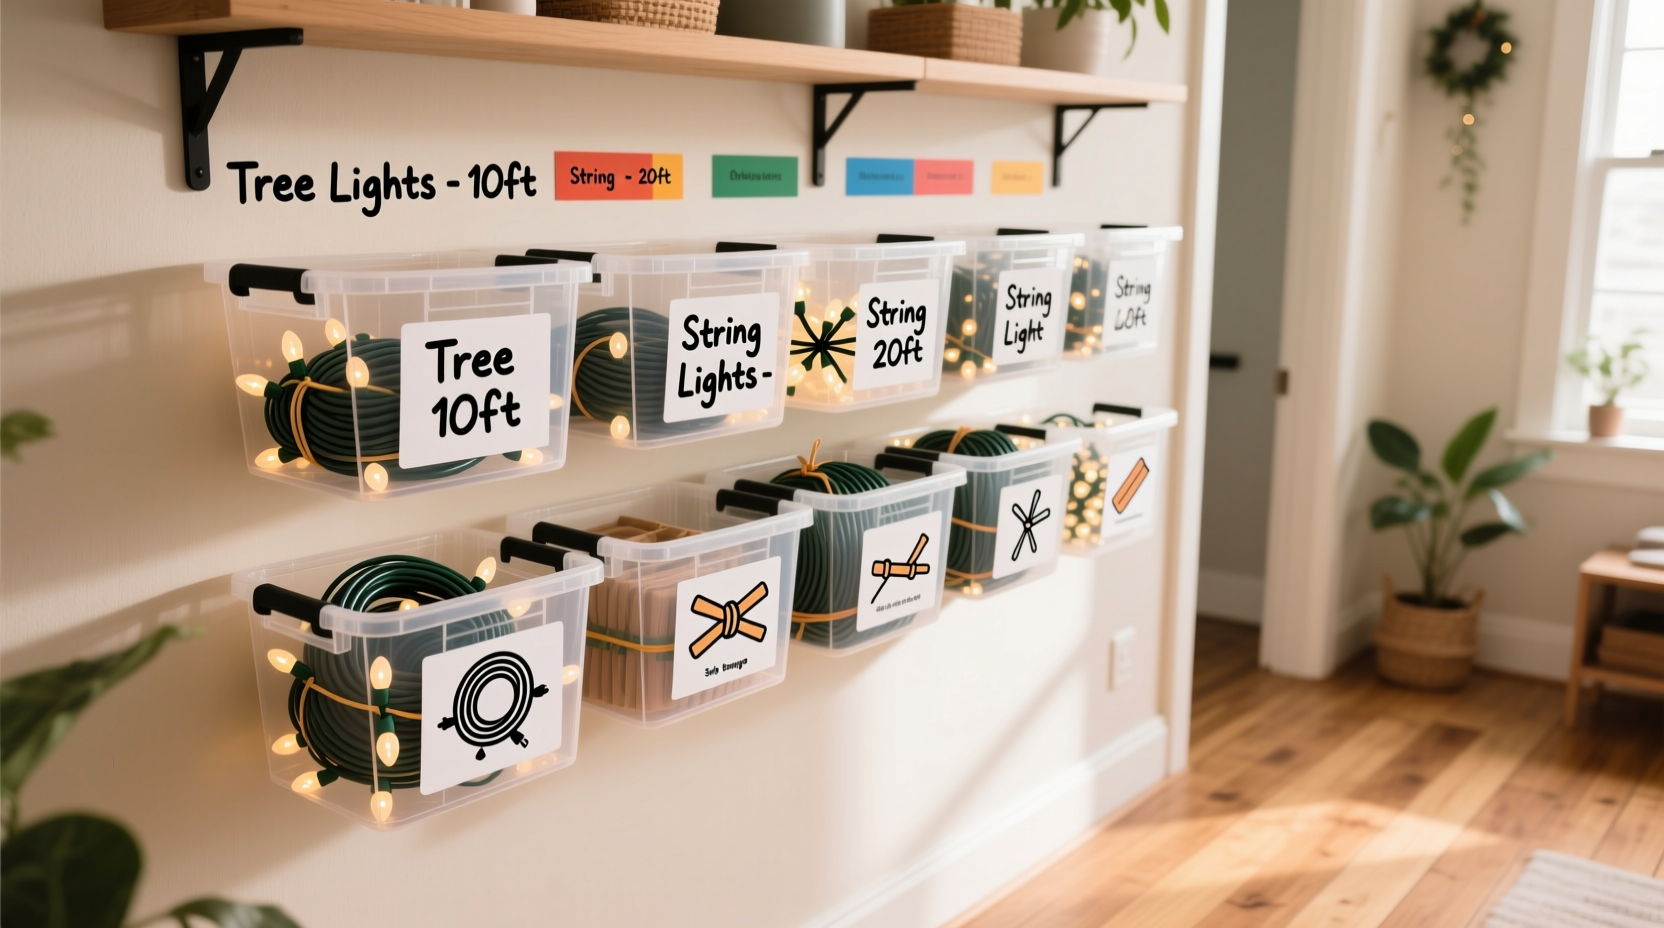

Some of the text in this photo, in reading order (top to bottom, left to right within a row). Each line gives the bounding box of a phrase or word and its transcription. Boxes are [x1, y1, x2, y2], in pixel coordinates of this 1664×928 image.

[226, 161, 316, 204] Tree
[330, 161, 437, 217] Lights
[468, 161, 538, 200] 10ft
[570, 166, 615, 191] String
[638, 166, 672, 184] 20ft
[1005, 284, 1052, 318] String
[1115, 274, 1151, 304] String
[867, 296, 927, 335] String
[681, 314, 761, 358] String
[873, 335, 924, 369] 20ft
[1004, 318, 1044, 354] Light
[425, 338, 515, 384] Tree
[431, 387, 521, 438] 10ft
